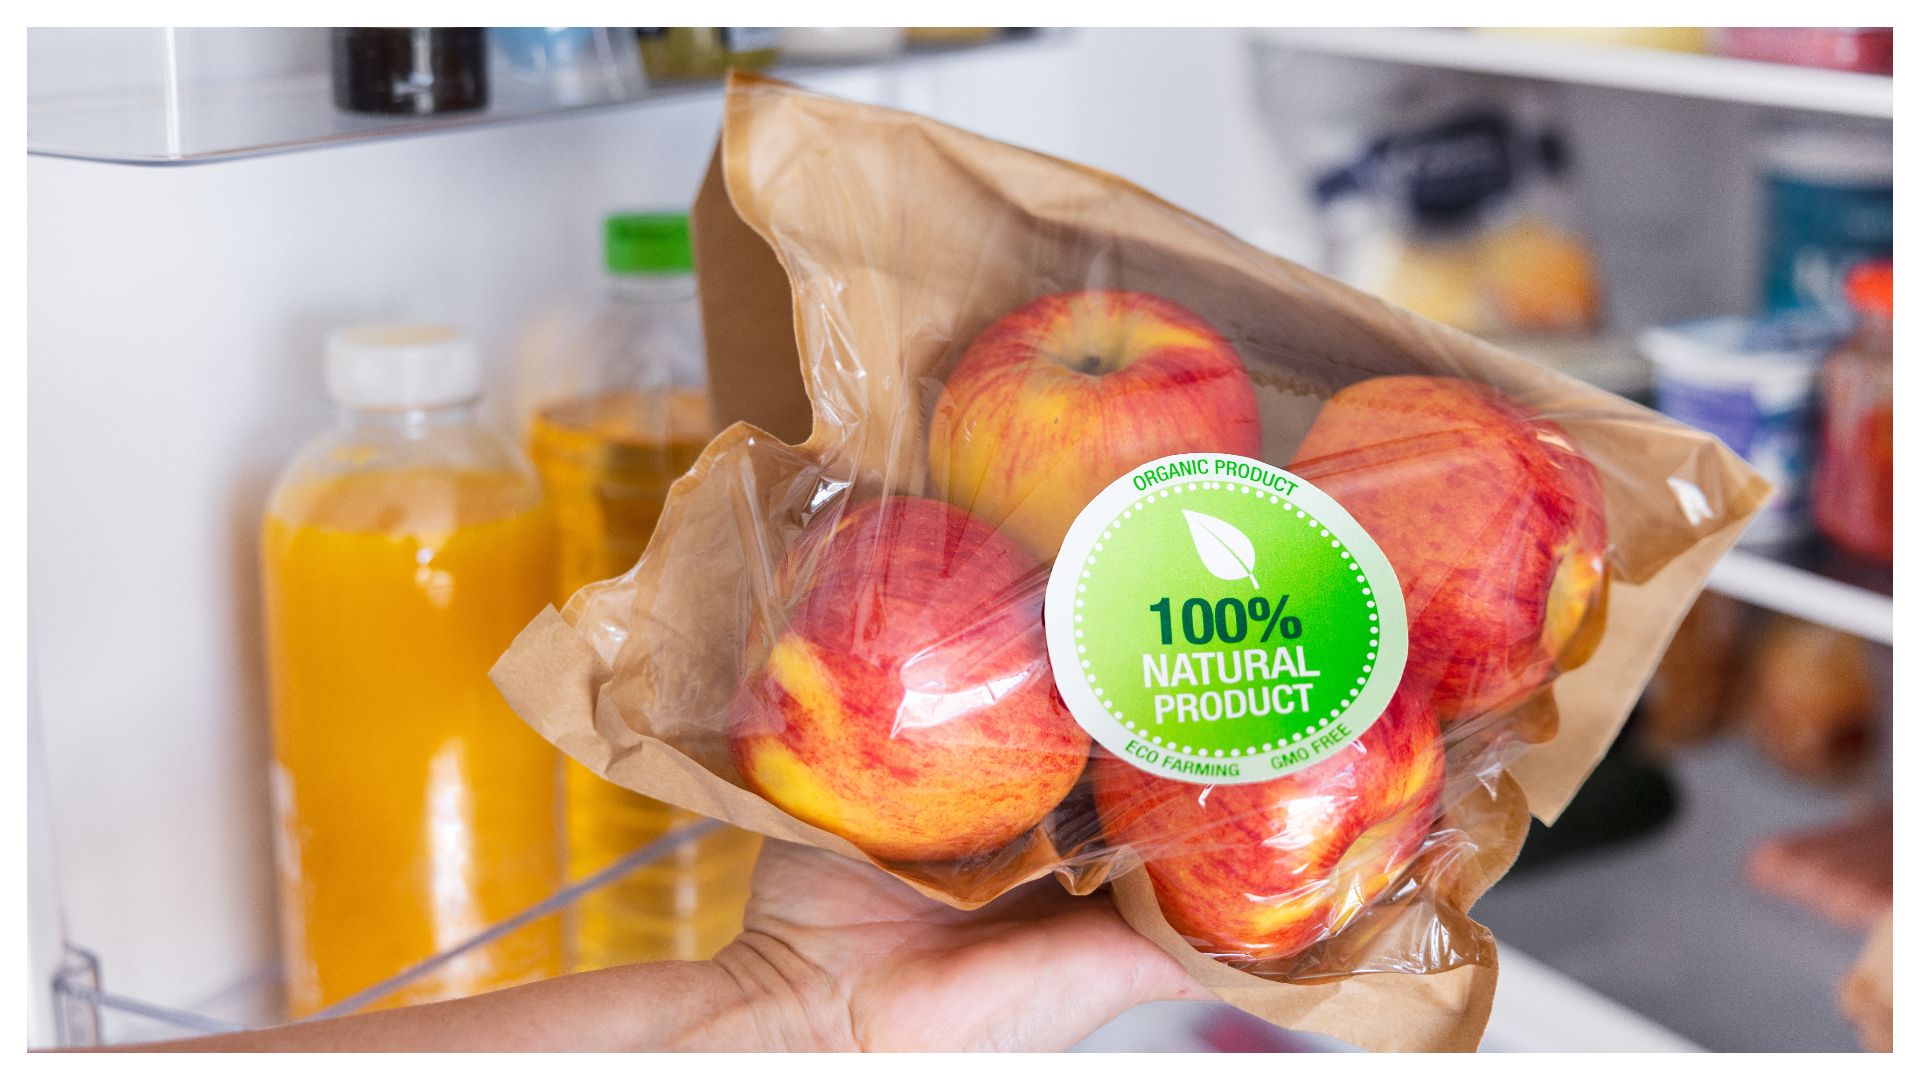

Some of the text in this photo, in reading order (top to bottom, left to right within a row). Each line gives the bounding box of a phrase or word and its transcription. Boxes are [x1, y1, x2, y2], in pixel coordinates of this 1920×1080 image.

[1133, 459, 1299, 497] ORGANIC PRODUCT
[1149, 594, 1302, 645] 100%
[1142, 645, 1321, 688] NATURAL
[1154, 683, 1314, 724] PRODUCT
[1125, 739, 1240, 777] ECO FARMING
[1270, 722, 1353, 771] GMO FREE
